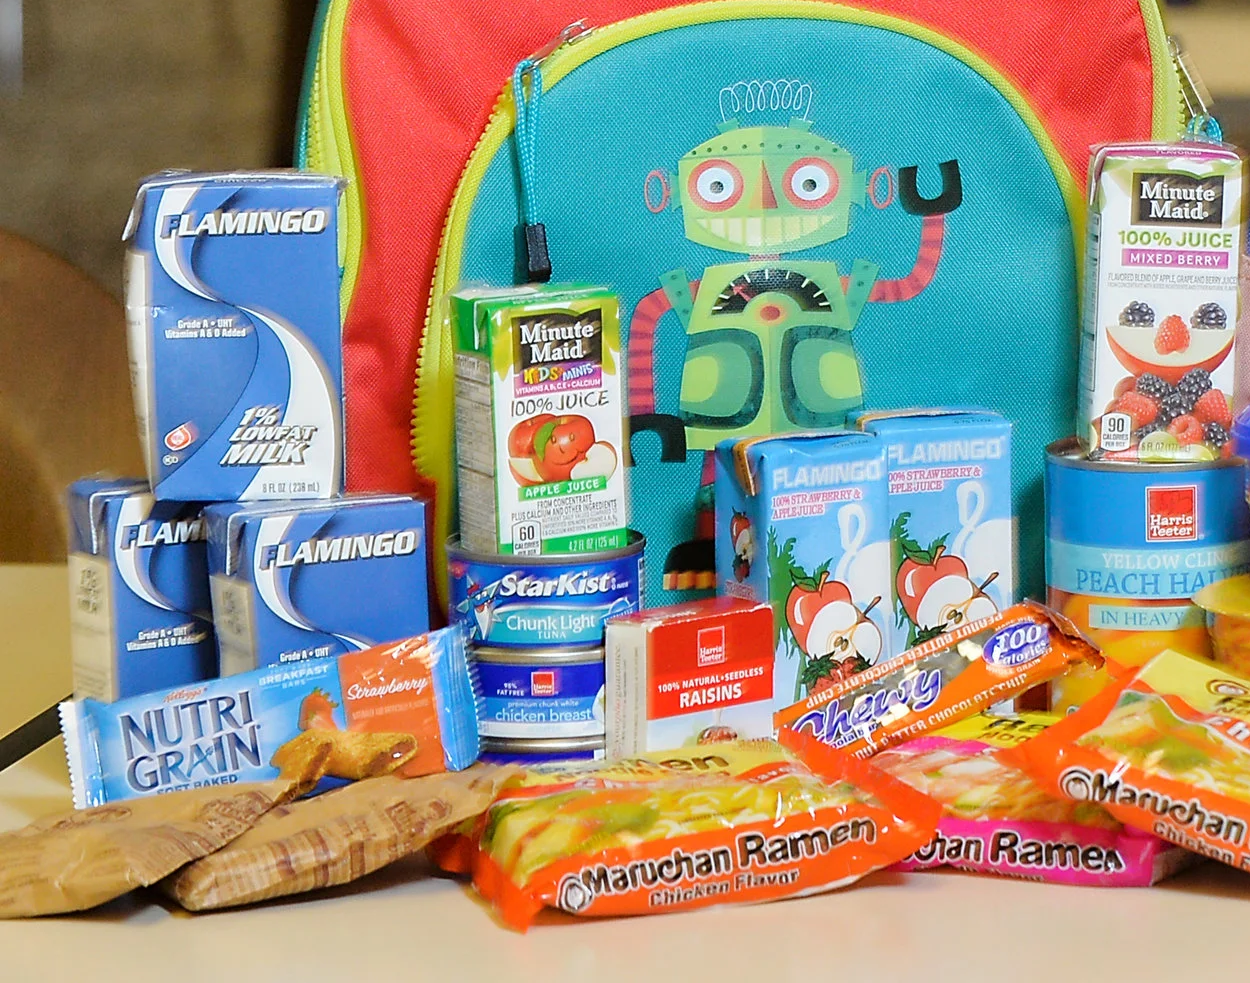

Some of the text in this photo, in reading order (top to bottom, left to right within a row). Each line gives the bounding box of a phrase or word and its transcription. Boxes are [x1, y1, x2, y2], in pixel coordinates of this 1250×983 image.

[1140, 181, 1216, 202] Minute
[1149, 200, 1203, 220] Maid
[160, 209, 327, 239] FLAMINGO
[1118, 230, 1233, 249] 100% JUICE
[1130, 252, 1221, 266] MIXED BERRY
[165, 326, 246, 340] Vitamins A Added
[178, 318, 233, 329] Grade A UHT
[520, 321, 595, 345] Minute
[530, 339, 584, 364] Maid
[571, 379, 601, 388] CALCIUM
[239, 407, 280, 426] 1%
[511, 397, 553, 418] 100%
[228, 425, 317, 444] LOWFAT
[1108, 417, 1124, 433] 90
[219, 441, 310, 467] MILK
[888, 436, 1005, 465] FLAMINGO
[773, 459, 884, 489] FLAMINGO
[906, 466, 982, 481] STRAWBERRY &
[262, 483, 268, 494] 8
[268, 483, 276, 494] FL
[525, 479, 600, 498] APPLE JUICE
[914, 479, 944, 492] JUICE
[537, 494, 592, 510] FROM CONCENTRATE
[772, 488, 862, 508] 100% STRAWBERRY &
[511, 511, 527, 521] PLUS
[526, 508, 552, 520] CALCIUM
[564, 504, 583, 515] OTHER
[583, 498, 617, 512] INGREDIENTS
[771, 503, 825, 520] APPLE JUICE
[1150, 514, 1193, 527] Harris
[519, 525, 535, 542] 60
[1150, 524, 1193, 537] Teeter
[257, 530, 419, 570] FLAMINGO
[1101, 552, 1181, 571] YELLOW
[500, 571, 610, 598] StarKist
[1076, 568, 1160, 595] PEACH
[506, 615, 557, 632] Chunk
[561, 614, 596, 634] Light
[1101, 610, 1184, 627] IN HEAVY
[138, 629, 166, 641] Grade A
[538, 631, 567, 640] TUNA
[996, 624, 1042, 654] 100
[279, 651, 301, 663] Grade
[301, 648, 308, 660] A
[700, 646, 723, 657] Harris
[700, 653, 723, 663] Teeter
[258, 664, 329, 686] BREAKFAST
[282, 679, 306, 689] BARS
[347, 676, 428, 700] Strawberry
[658, 682, 680, 694] 100%
[679, 683, 743, 709] RAISINS
[539, 700, 560, 708] chunk
[805, 687, 834, 709] CHIP
[495, 708, 592, 723] chicken breast
[119, 690, 254, 761] NUTRI
[127, 724, 262, 792] GRAIN
[193, 773, 239, 789] BAKED
[1094, 768, 1247, 848] Maruchan
[989, 828, 1126, 874] Ramen
[1152, 820, 1235, 868] Chicken
[580, 815, 878, 898] Maruchan Ramen
[648, 867, 799, 909] Chicken Flavor
